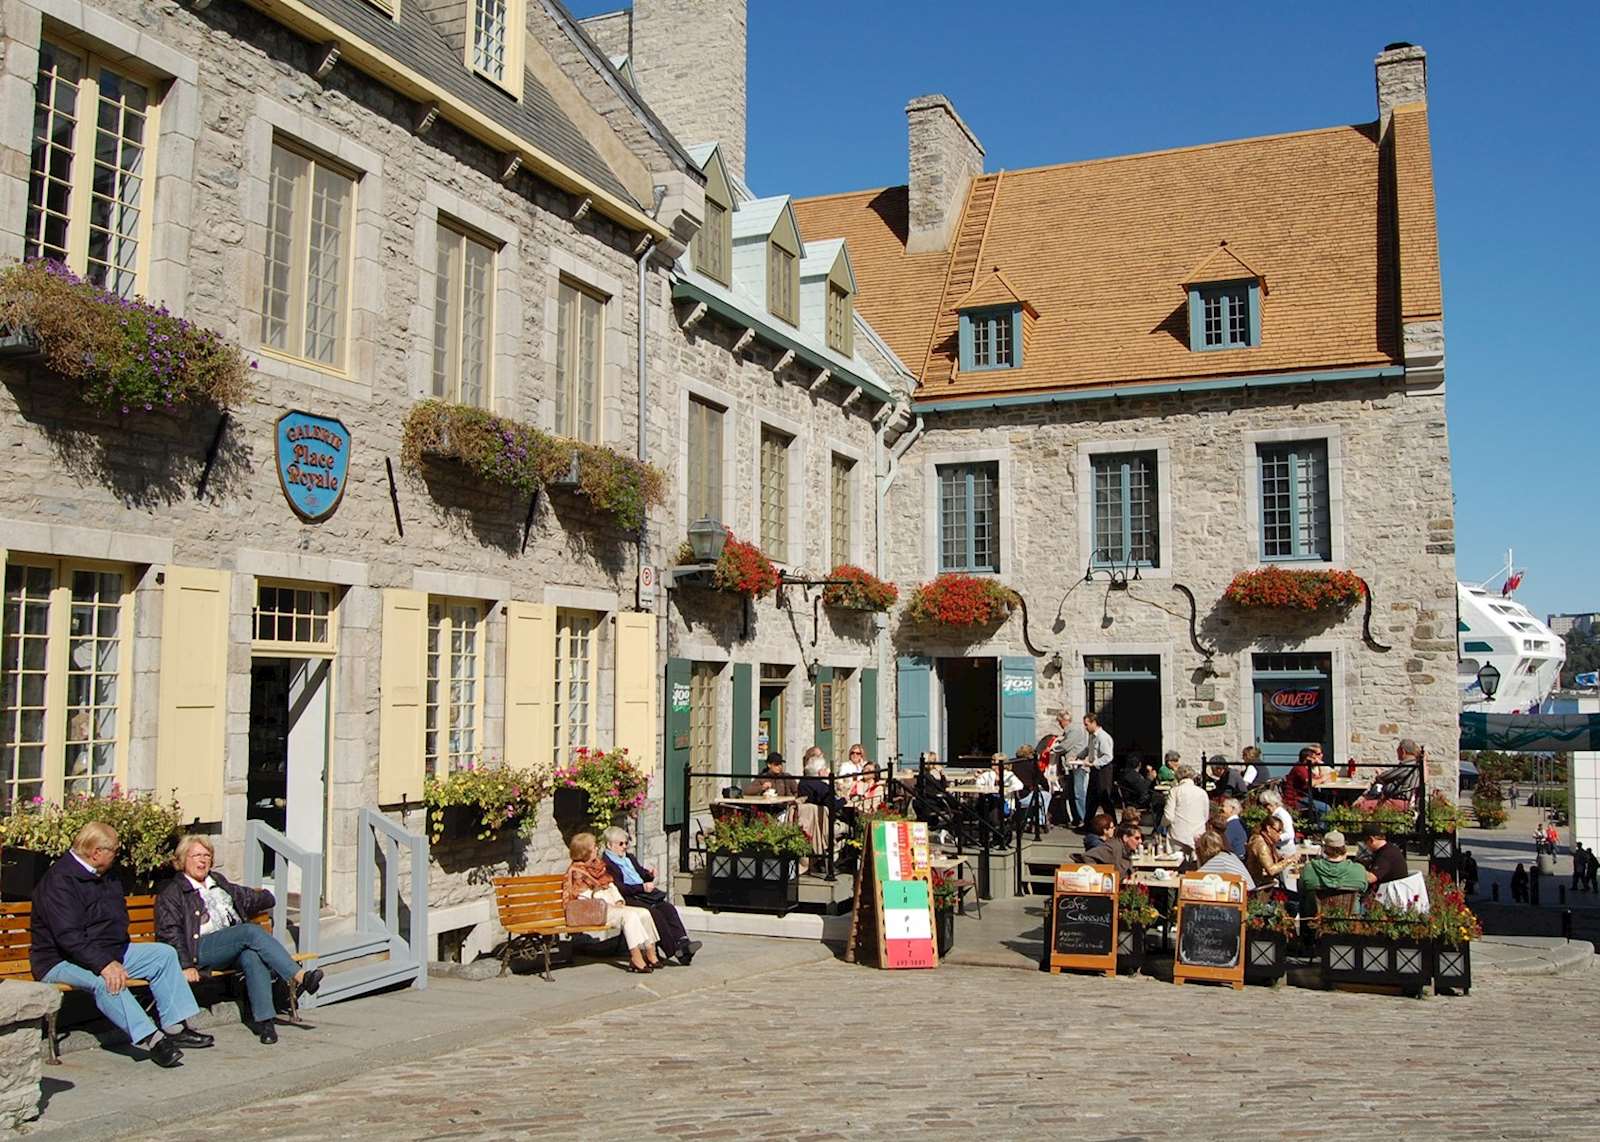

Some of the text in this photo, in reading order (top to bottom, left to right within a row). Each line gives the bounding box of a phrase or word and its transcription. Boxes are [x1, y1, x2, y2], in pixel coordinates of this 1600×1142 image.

[293, 444, 334, 469] Place
[287, 464, 338, 491] Royale
[1275, 691, 1318, 706] OUVERT
